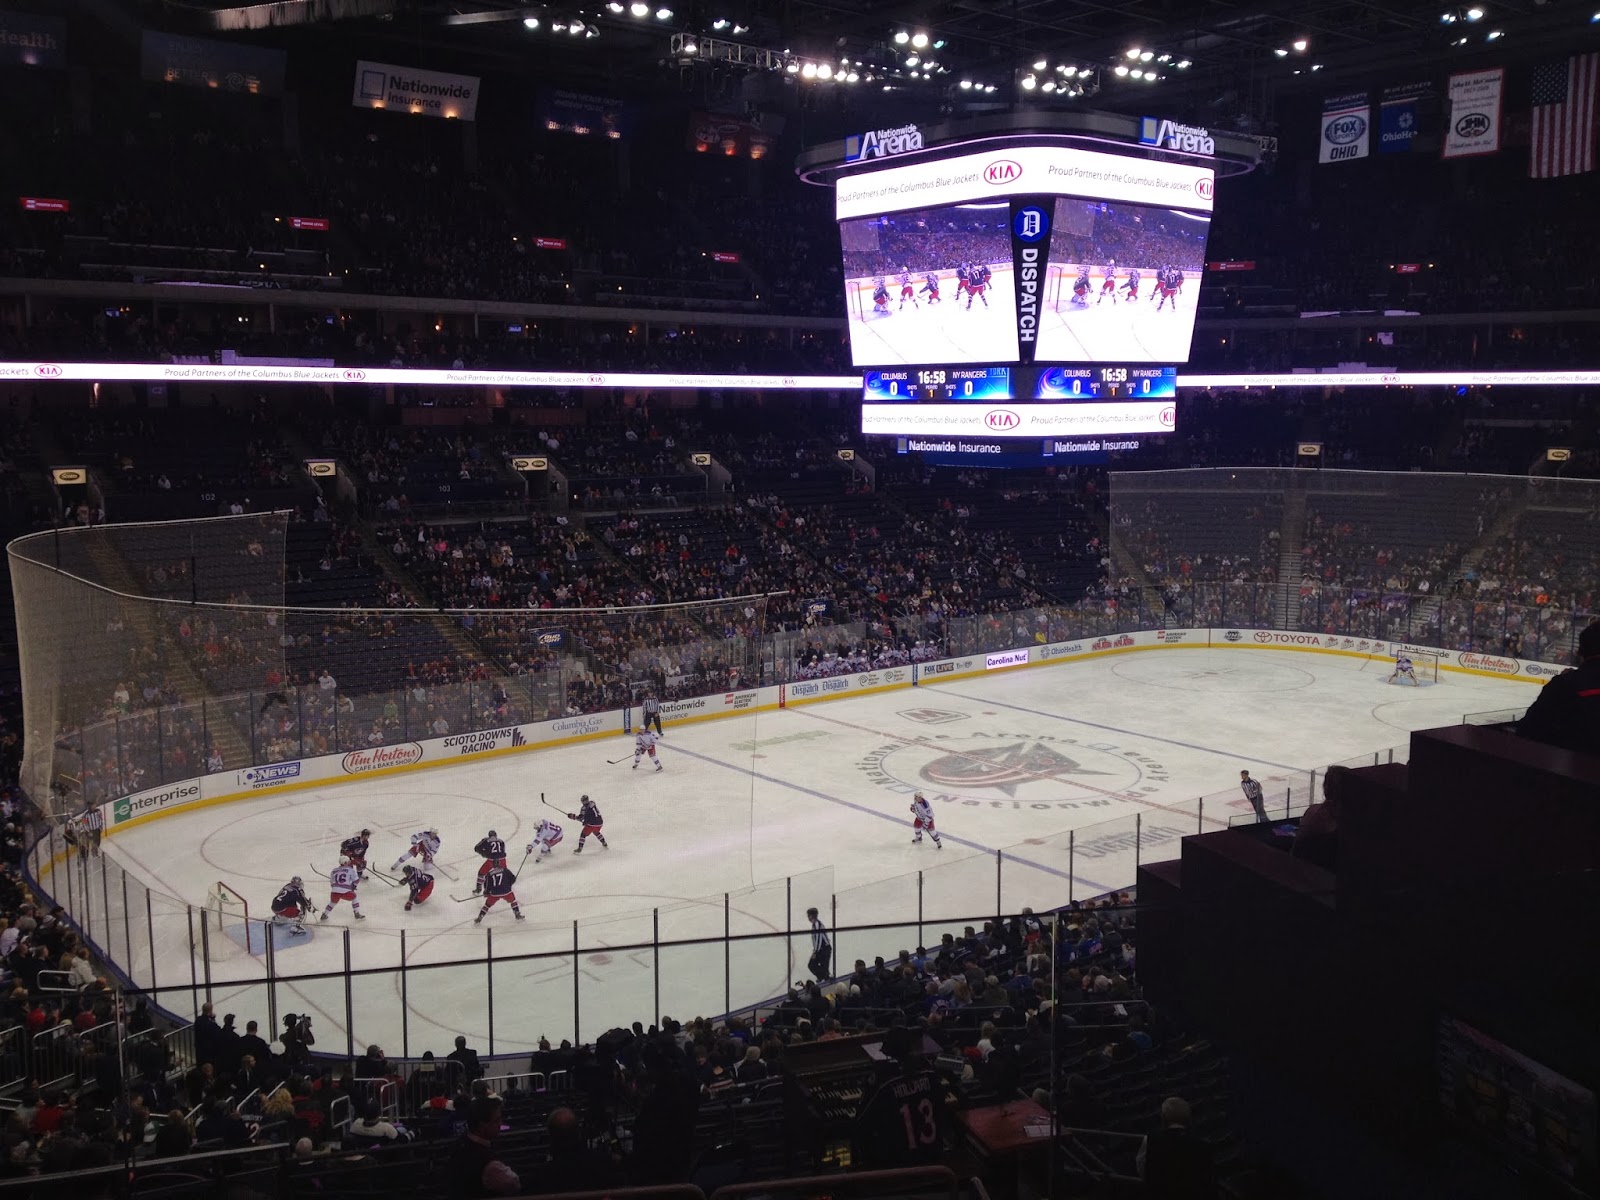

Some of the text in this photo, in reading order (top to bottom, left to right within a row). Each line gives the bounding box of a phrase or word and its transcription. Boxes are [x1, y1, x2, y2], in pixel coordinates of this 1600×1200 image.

[389, 76, 471, 99] Nationwide
[388, 91, 442, 109] Insurance
[878, 123, 917, 139] Nationwide
[1173, 122, 1208, 137] Nationwide
[1334, 120, 1357, 134] FOX
[1156, 119, 1215, 155] Arena
[860, 131, 924, 160] Arena
[1330, 145, 1358, 159] OHIO
[853, 190, 879, 200] Partners
[880, 187, 887, 196] of
[888, 185, 899, 195] the
[900, 181, 934, 193] Columbus
[935, 178, 951, 188] Blue
[952, 173, 979, 185] Jackets
[989, 165, 1014, 180] KIA
[1048, 165, 1073, 176] Proud
[1074, 167, 1103, 180] Partners
[1104, 171, 1111, 180] of
[1123, 174, 1155, 187] Columbus
[1156, 178, 1169, 188] Blue
[1020, 248, 1038, 342] DISPATCH
[165, 369, 190, 377] Proud
[191, 369, 226, 377] Partners
[228, 369, 237, 377] of
[237, 369, 251, 377] the
[252, 370, 292, 378] Columbus
[294, 370, 310, 378] Blue
[312, 370, 339, 379] Jackets
[882, 372, 907, 380] COLUMBUS
[918, 371, 946, 384] 16:58
[961, 370, 987, 379] RANGERS
[1064, 370, 1091, 378] COLUMBUS
[1101, 368, 1127, 382] 16:58
[890, 382, 898, 396] 0
[965, 381, 973, 396] 0
[1073, 380, 1081, 394] 0
[1143, 379, 1150, 394] 0
[1031, 415, 1053, 424] Proud
[909, 441, 1001, 453] Nationwide Insurance
[1055, 440, 1139, 452] Nationwide Insurance
[201, 493, 216, 501] 102
[1274, 634, 1319, 645] TOYOTA
[1051, 644, 1082, 656] OhioHealth
[987, 656, 1013, 666] Carolina
[1464, 652, 1514, 669] Tim Hortons
[924, 665, 935, 673] FOX
[938, 664, 953, 672] LIVE
[792, 683, 818, 695] Dispatch
[823, 679, 848, 691] Dispatch
[659, 700, 705, 714] Nationwide
[660, 712, 688, 721] nsurance
[552, 717, 603, 731] Columbia Gas
[579, 726, 599, 735] Ohio
[443, 729, 512, 748] SCIOTO DOWNS
[461, 741, 496, 754] RACINO
[349, 748, 416, 767] Tim Hortons
[396, 758, 412, 766] SHOP
[258, 765, 298, 781] NEWS
[114, 786, 198, 815] enterprise
[490, 841, 502, 853] 21
[334, 873, 347, 883] 16
[491, 873, 503, 887] 17
[900, 1098, 936, 1150] 13
